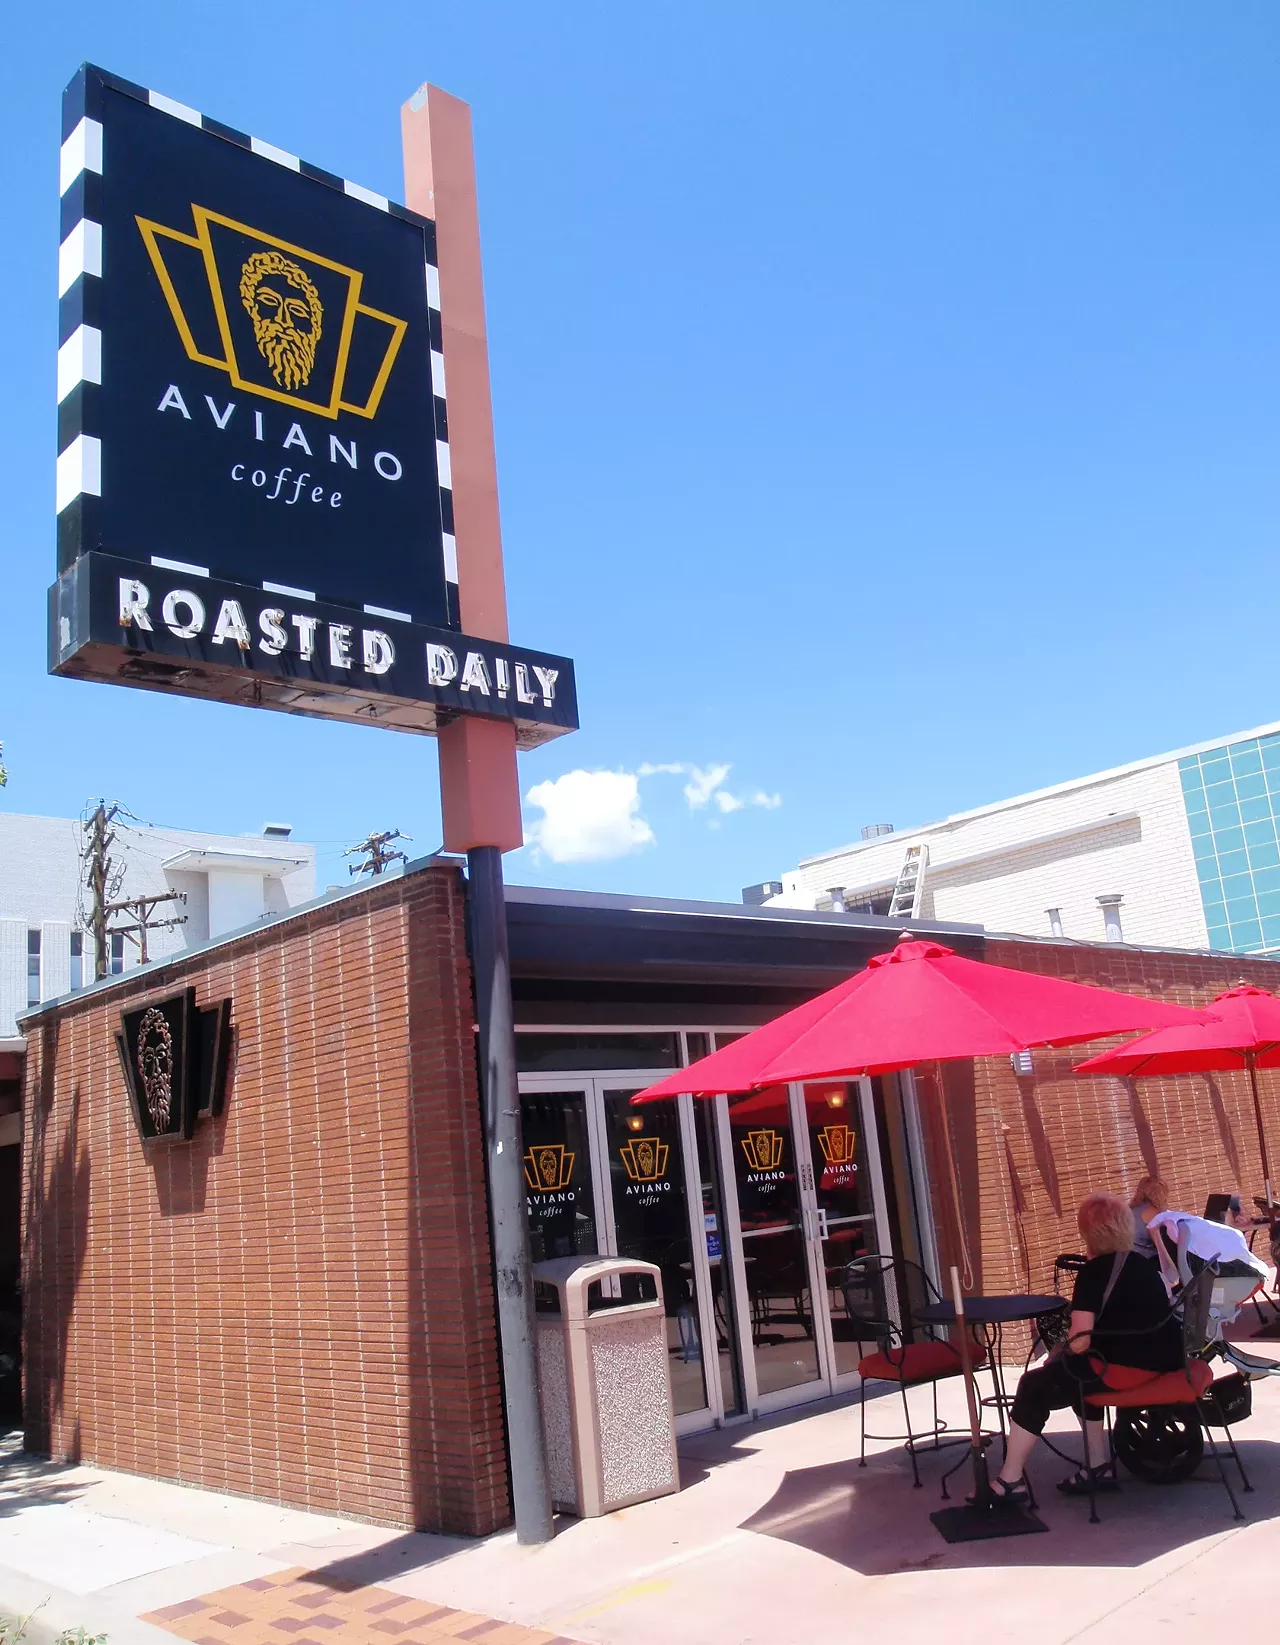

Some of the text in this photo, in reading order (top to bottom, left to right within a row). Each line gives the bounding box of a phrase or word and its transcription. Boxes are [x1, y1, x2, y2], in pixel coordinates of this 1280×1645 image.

[157, 384, 403, 481] AVIANO
[231, 462, 343, 508] coffee
[119, 577, 560, 708] ROASTED DAILY
[823, 1163, 858, 1175] AVIANO
[747, 1171, 785, 1182] AVIANO
[833, 1175, 850, 1185] coffee
[625, 1182, 671, 1195] AVIANO
[758, 1182, 776, 1193] coffee
[638, 1195, 660, 1206] coffee
[539, 1206, 563, 1218] coffee
